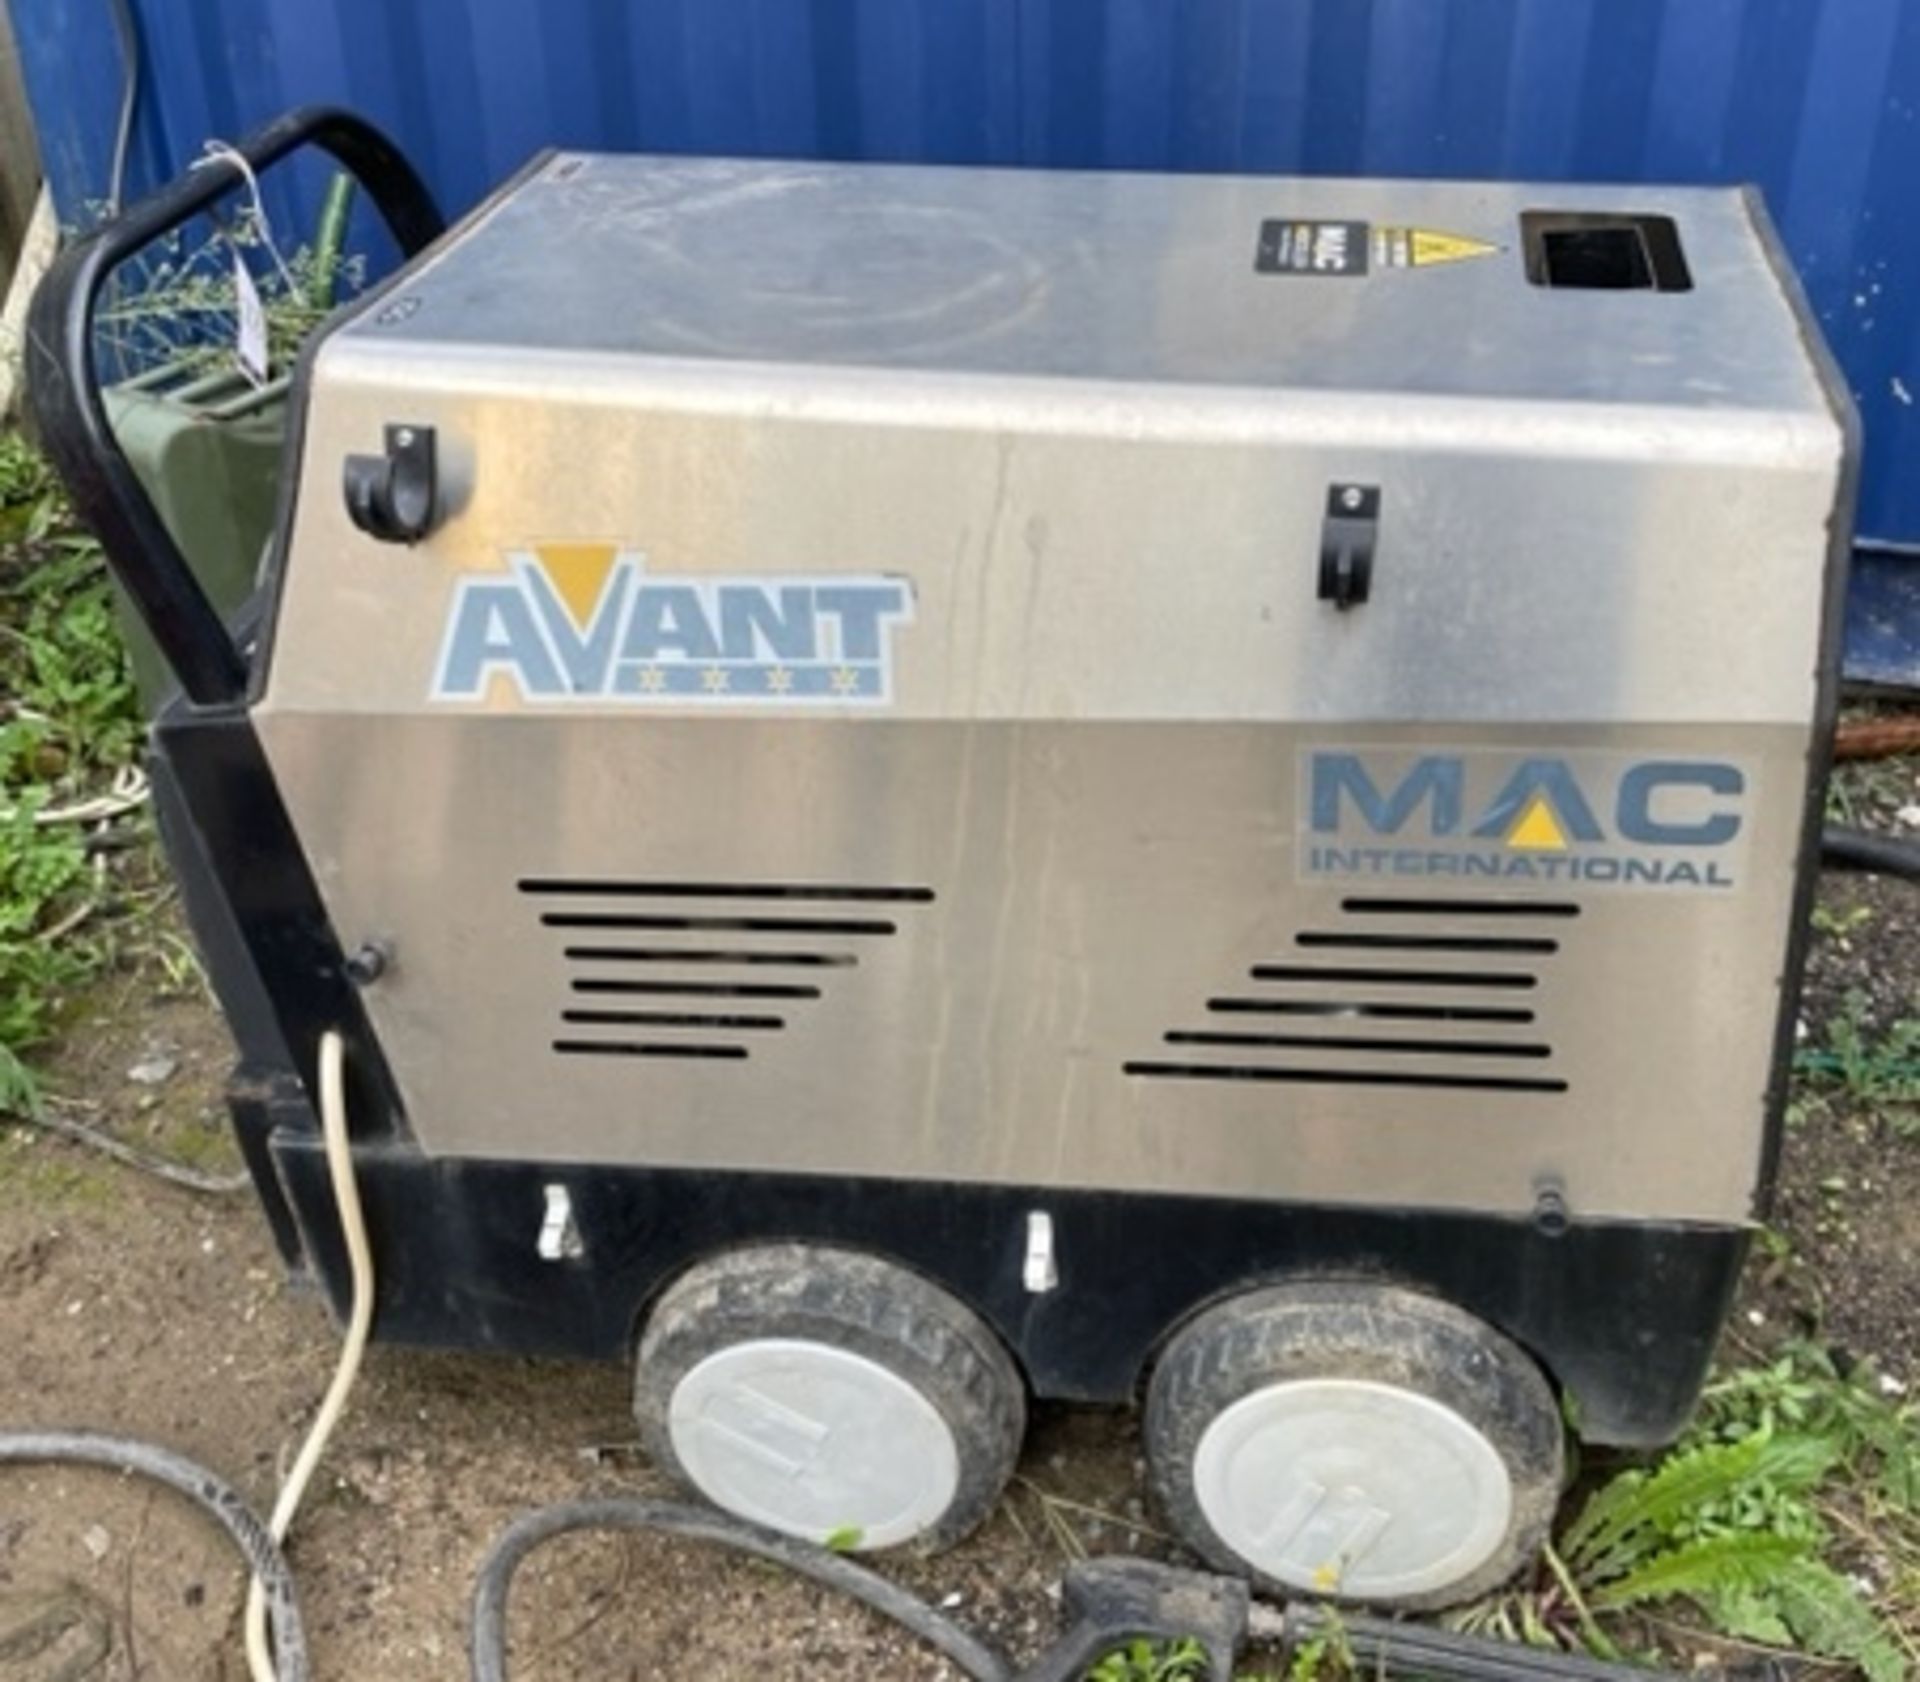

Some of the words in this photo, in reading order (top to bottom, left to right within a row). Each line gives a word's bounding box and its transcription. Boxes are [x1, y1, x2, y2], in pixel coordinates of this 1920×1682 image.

[438, 560, 907, 695] AVANT
[1310, 753, 1745, 848] MAC
[1309, 847, 1734, 888] INTERNATIONAL
